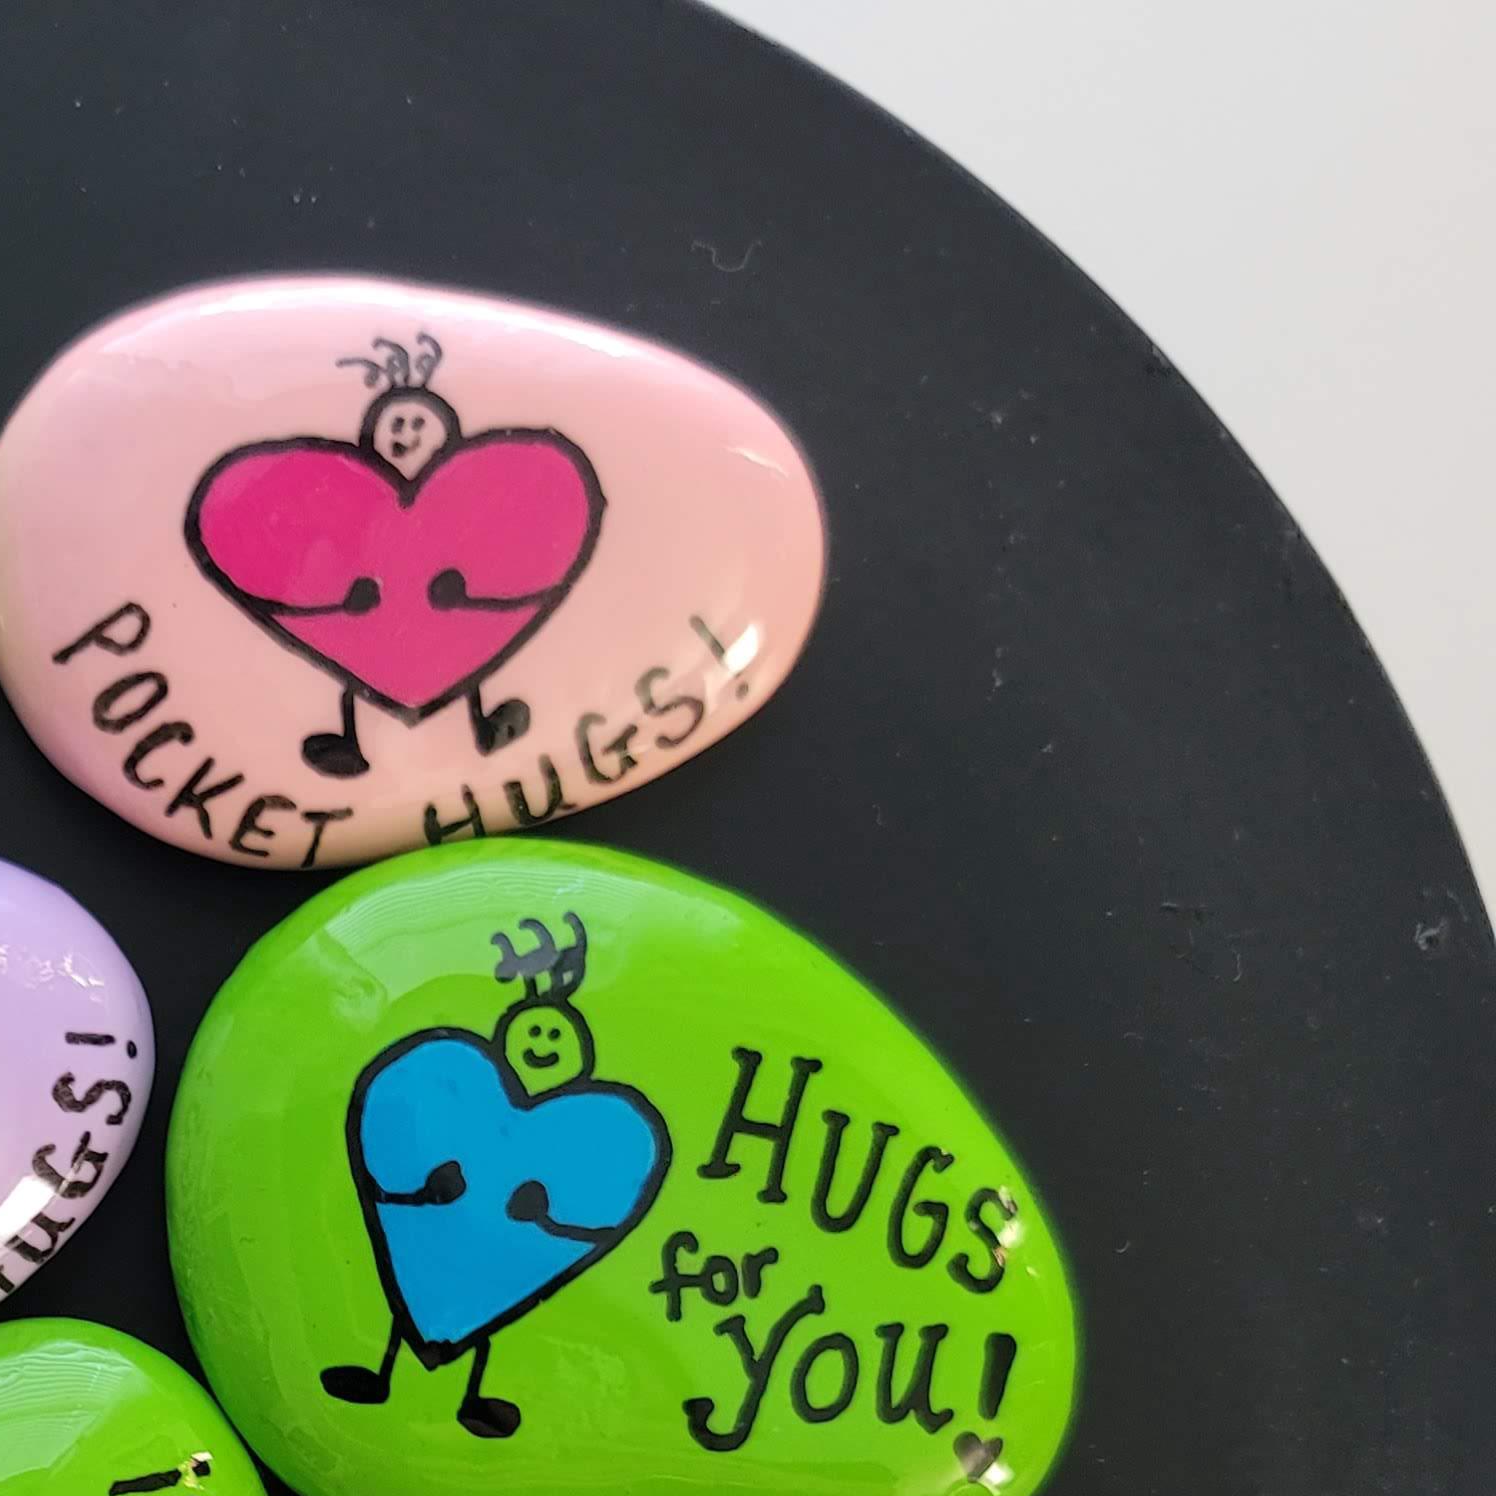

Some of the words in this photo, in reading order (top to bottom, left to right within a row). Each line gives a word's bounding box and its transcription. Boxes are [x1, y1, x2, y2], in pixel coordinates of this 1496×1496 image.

[52, 601, 354, 869] POCKET
[424, 615, 753, 845] HUGS!
[648, 1230, 780, 1322] for
[696, 1045, 1018, 1295] HUGS
